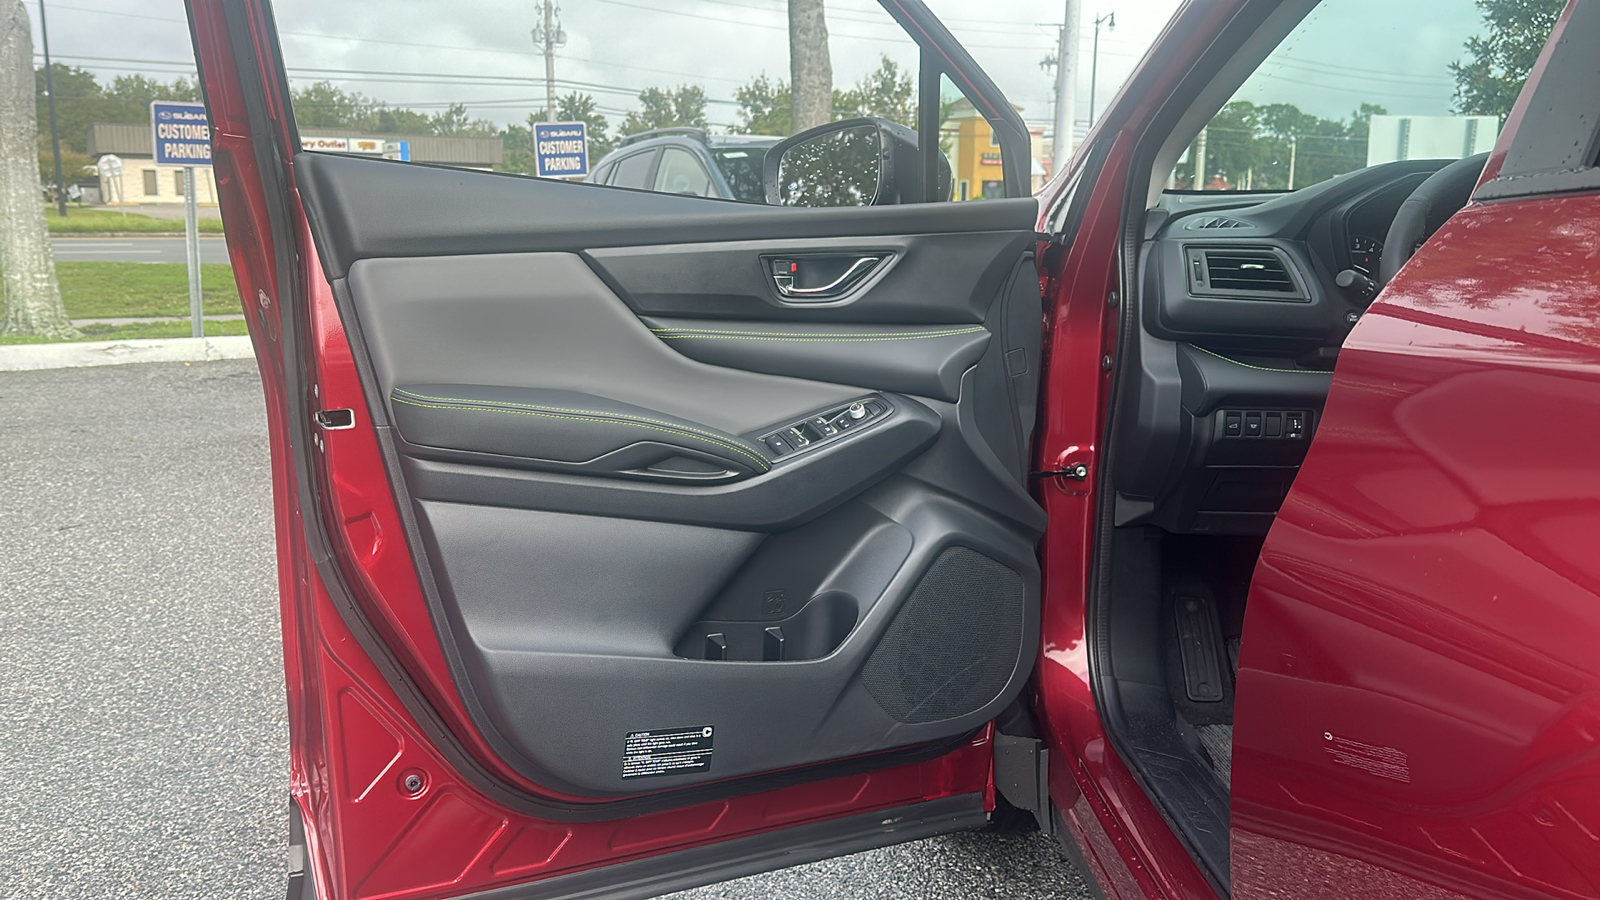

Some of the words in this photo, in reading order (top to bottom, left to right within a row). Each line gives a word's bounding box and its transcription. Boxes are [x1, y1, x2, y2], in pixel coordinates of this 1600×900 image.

[172, 111, 207, 121] SUBAR
[158, 123, 210, 140] CUSTOME
[549, 129, 582, 137] SUBARU
[164, 142, 211, 159] PARKING
[317, 140, 346, 149] Outlet
[539, 140, 584, 155] CUSTOMER
[544, 156, 581, 171] PARKING
